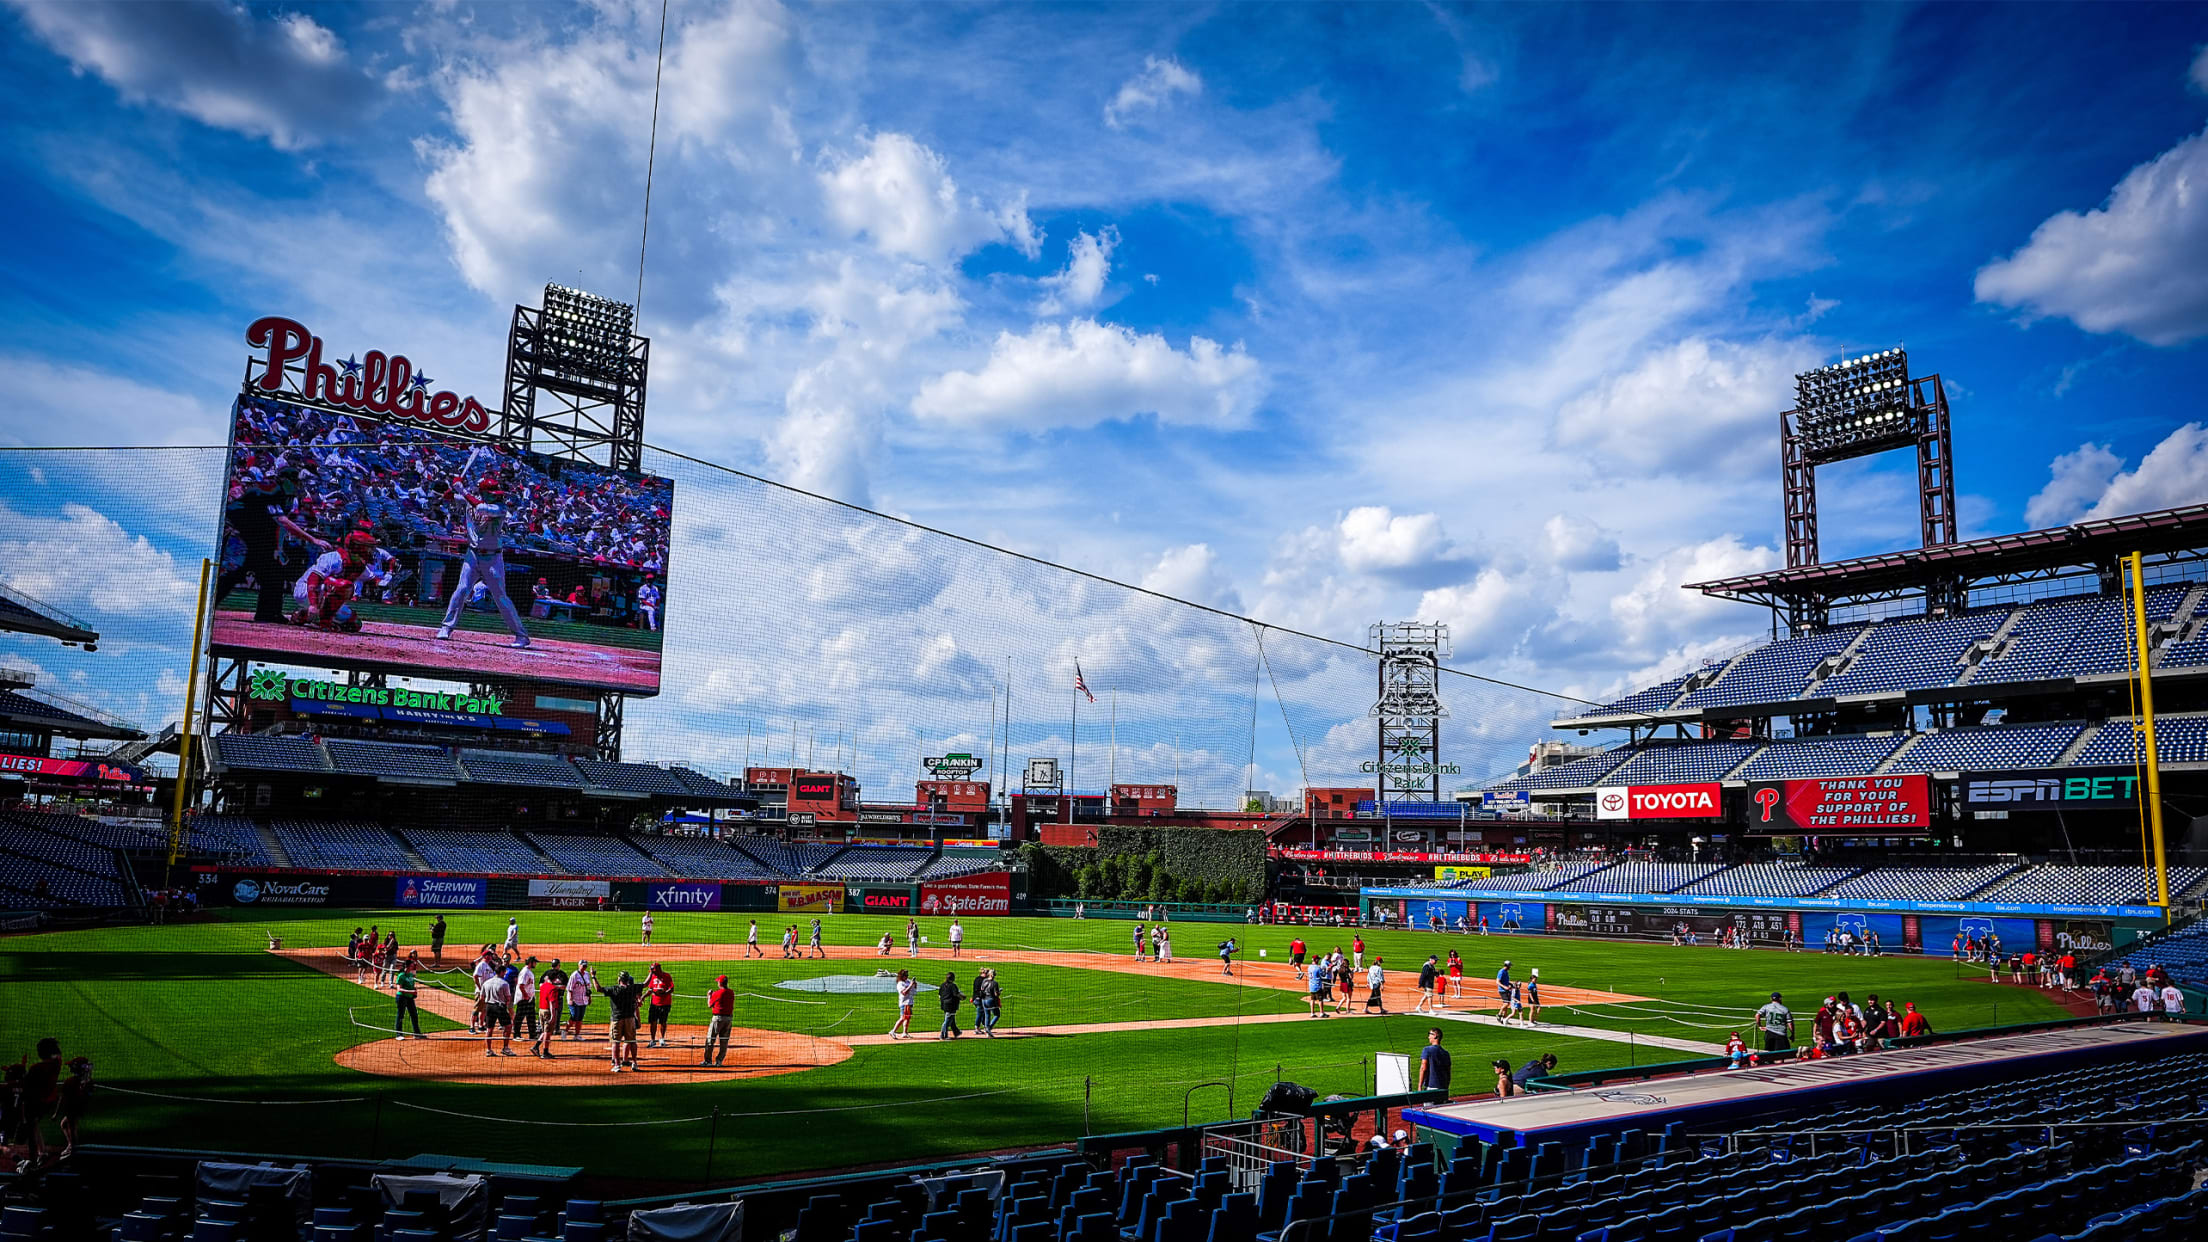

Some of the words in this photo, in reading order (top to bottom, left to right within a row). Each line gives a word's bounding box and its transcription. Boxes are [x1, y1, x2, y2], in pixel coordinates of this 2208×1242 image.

[246, 316, 490, 433] Phillies
[292, 679, 389, 705] Citizens
[394, 688, 451, 711] Bank
[454, 693, 504, 715] Park
[396, 709, 438, 719] HARRY
[1, 757, 43, 771] LIES!
[1362, 761, 1419, 774] Citizens
[1423, 761, 1456, 774] Bank
[800, 784, 832, 793] GIANT
[1394, 777, 1425, 789] Park
[1820, 780, 1866, 790] THANK
[1874, 778, 1904, 788] YOU
[1968, 778, 2061, 802] ESPN
[2064, 776, 2141, 800] BET
[1825, 790, 1853, 801] FOR
[1859, 788, 1898, 800] YOUR
[1632, 792, 1713, 810] TOYOTA
[1755, 788, 1779, 822] P
[1816, 803, 1881, 813] SUPPORT
[1888, 802, 1909, 811] OF
[1809, 816, 1838, 825] THE
[1842, 814, 1918, 825] PHILLIES!
[199, 873, 219, 885] 334
[1459, 870, 1484, 878] PLAY
[261, 880, 330, 897] NovaCare
[421, 879, 477, 893] SHERWIN
[764, 886, 777, 895] 374
[656, 886, 714, 908] xfinity
[848, 888, 860, 897] 387
[261, 896, 327, 904] REHABILITATION
[553, 897, 586, 908] LAGER
[864, 895, 910, 907] GIANT
[943, 894, 978, 911] State
[978, 896, 1009, 911] Farm
[1917, 902, 1958, 910] Independence
[1136, 911, 1148, 920] 401
[1680, 908, 1699, 916] STATS
[2053, 906, 2099, 914] Independence
[1556, 912, 1588, 927] Phillies
[1735, 921, 1747, 929] 172
[1751, 921, 1765, 930] .418
[1769, 922, 1783, 930] .451
[2056, 932, 2112, 951] Phillies
[1769, 1012, 1784, 1026] 15
